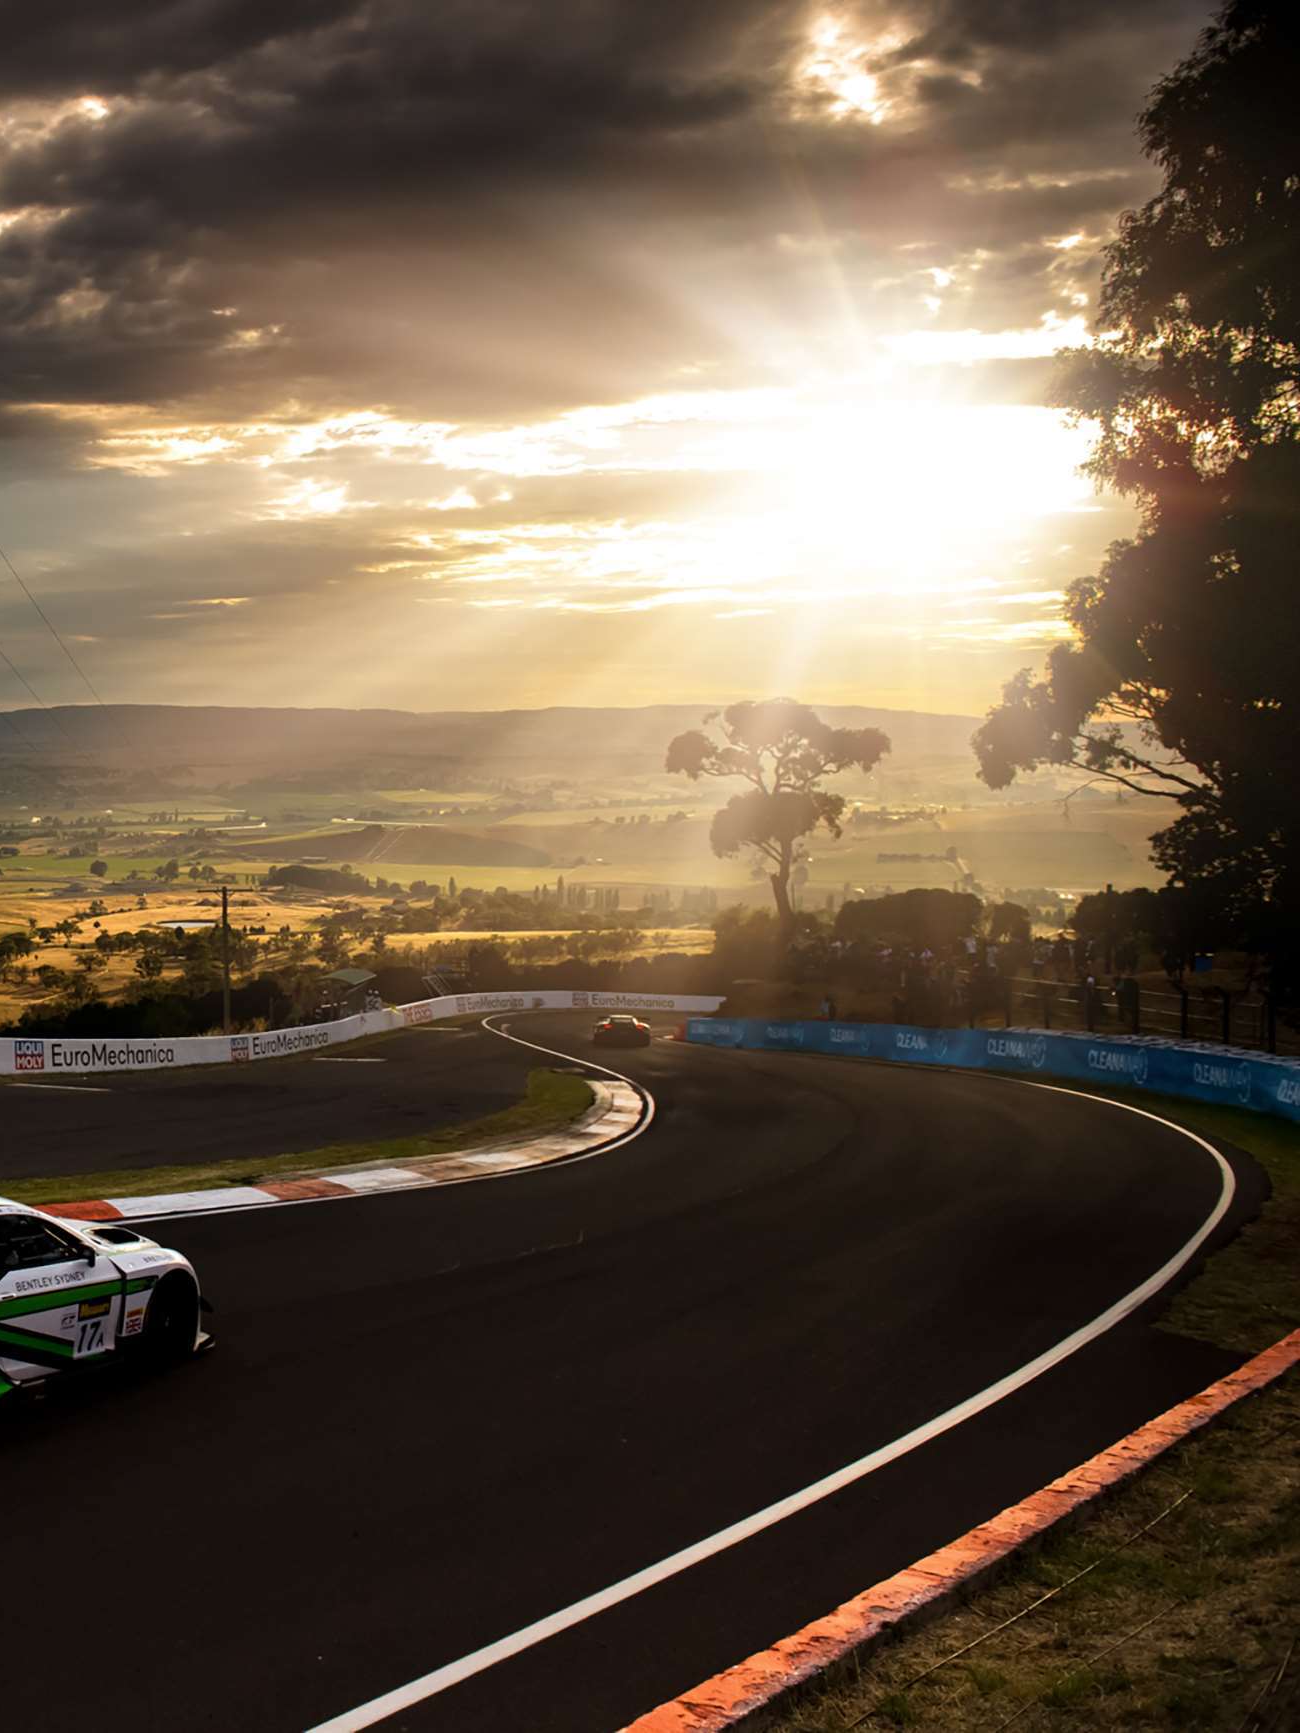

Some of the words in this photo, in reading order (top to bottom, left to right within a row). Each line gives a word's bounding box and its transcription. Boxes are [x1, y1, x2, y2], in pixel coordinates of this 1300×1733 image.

[16, 1041, 43, 1055] LIQUI
[253, 1029, 328, 1055] EuroMechanica
[16, 1056, 45, 1069] MOLY
[51, 1043, 175, 1067] EuroMechanica
[15, 1277, 53, 1292] BENTLEY
[55, 1271, 86, 1285] SYDNEY
